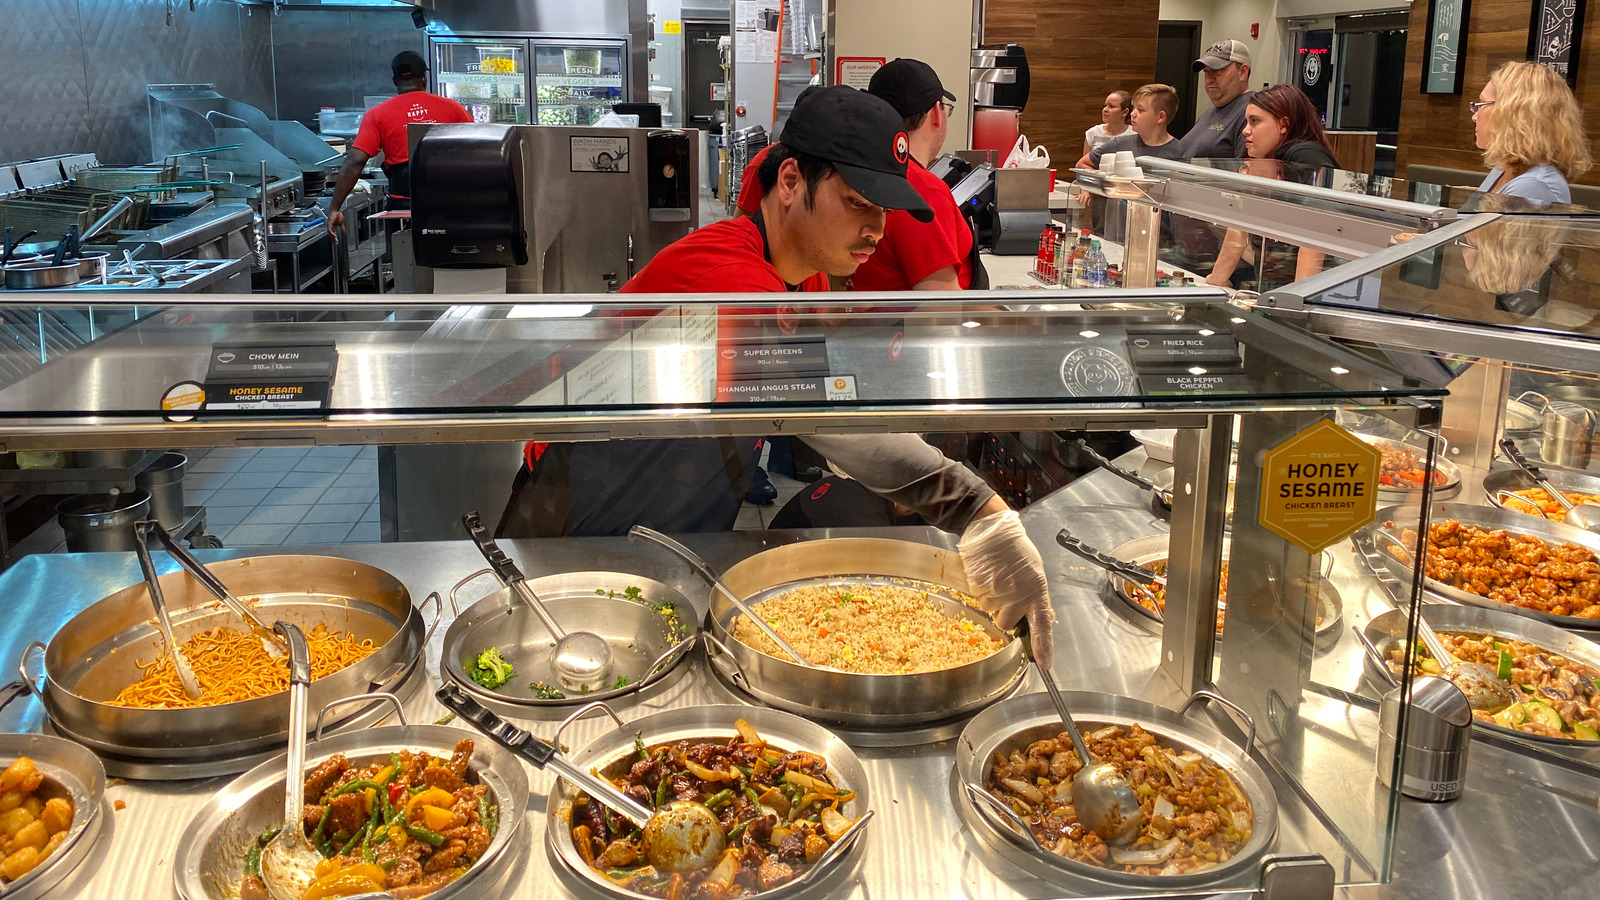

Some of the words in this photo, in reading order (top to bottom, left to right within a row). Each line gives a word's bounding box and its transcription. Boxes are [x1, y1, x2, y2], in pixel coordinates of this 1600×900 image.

[466, 64, 495, 72] FRESH
[464, 75, 498, 83] VEGGIES
[562, 78, 596, 86] VEGGIES
[407, 109, 428, 118] HAPPY
[771, 348, 803, 356] GREENS
[229, 386, 263, 395] HONEY
[263, 386, 303, 395] SESAME
[717, 385, 760, 393] SHANGHAI
[791, 383, 817, 391] STEAK
[1287, 463, 1360, 479] HONEY
[1279, 482, 1365, 498] SESAME
[1284, 502, 1322, 510] CHICKEN
[1323, 501, 1356, 509] BREAST
[1431, 782, 1458, 792] USED
